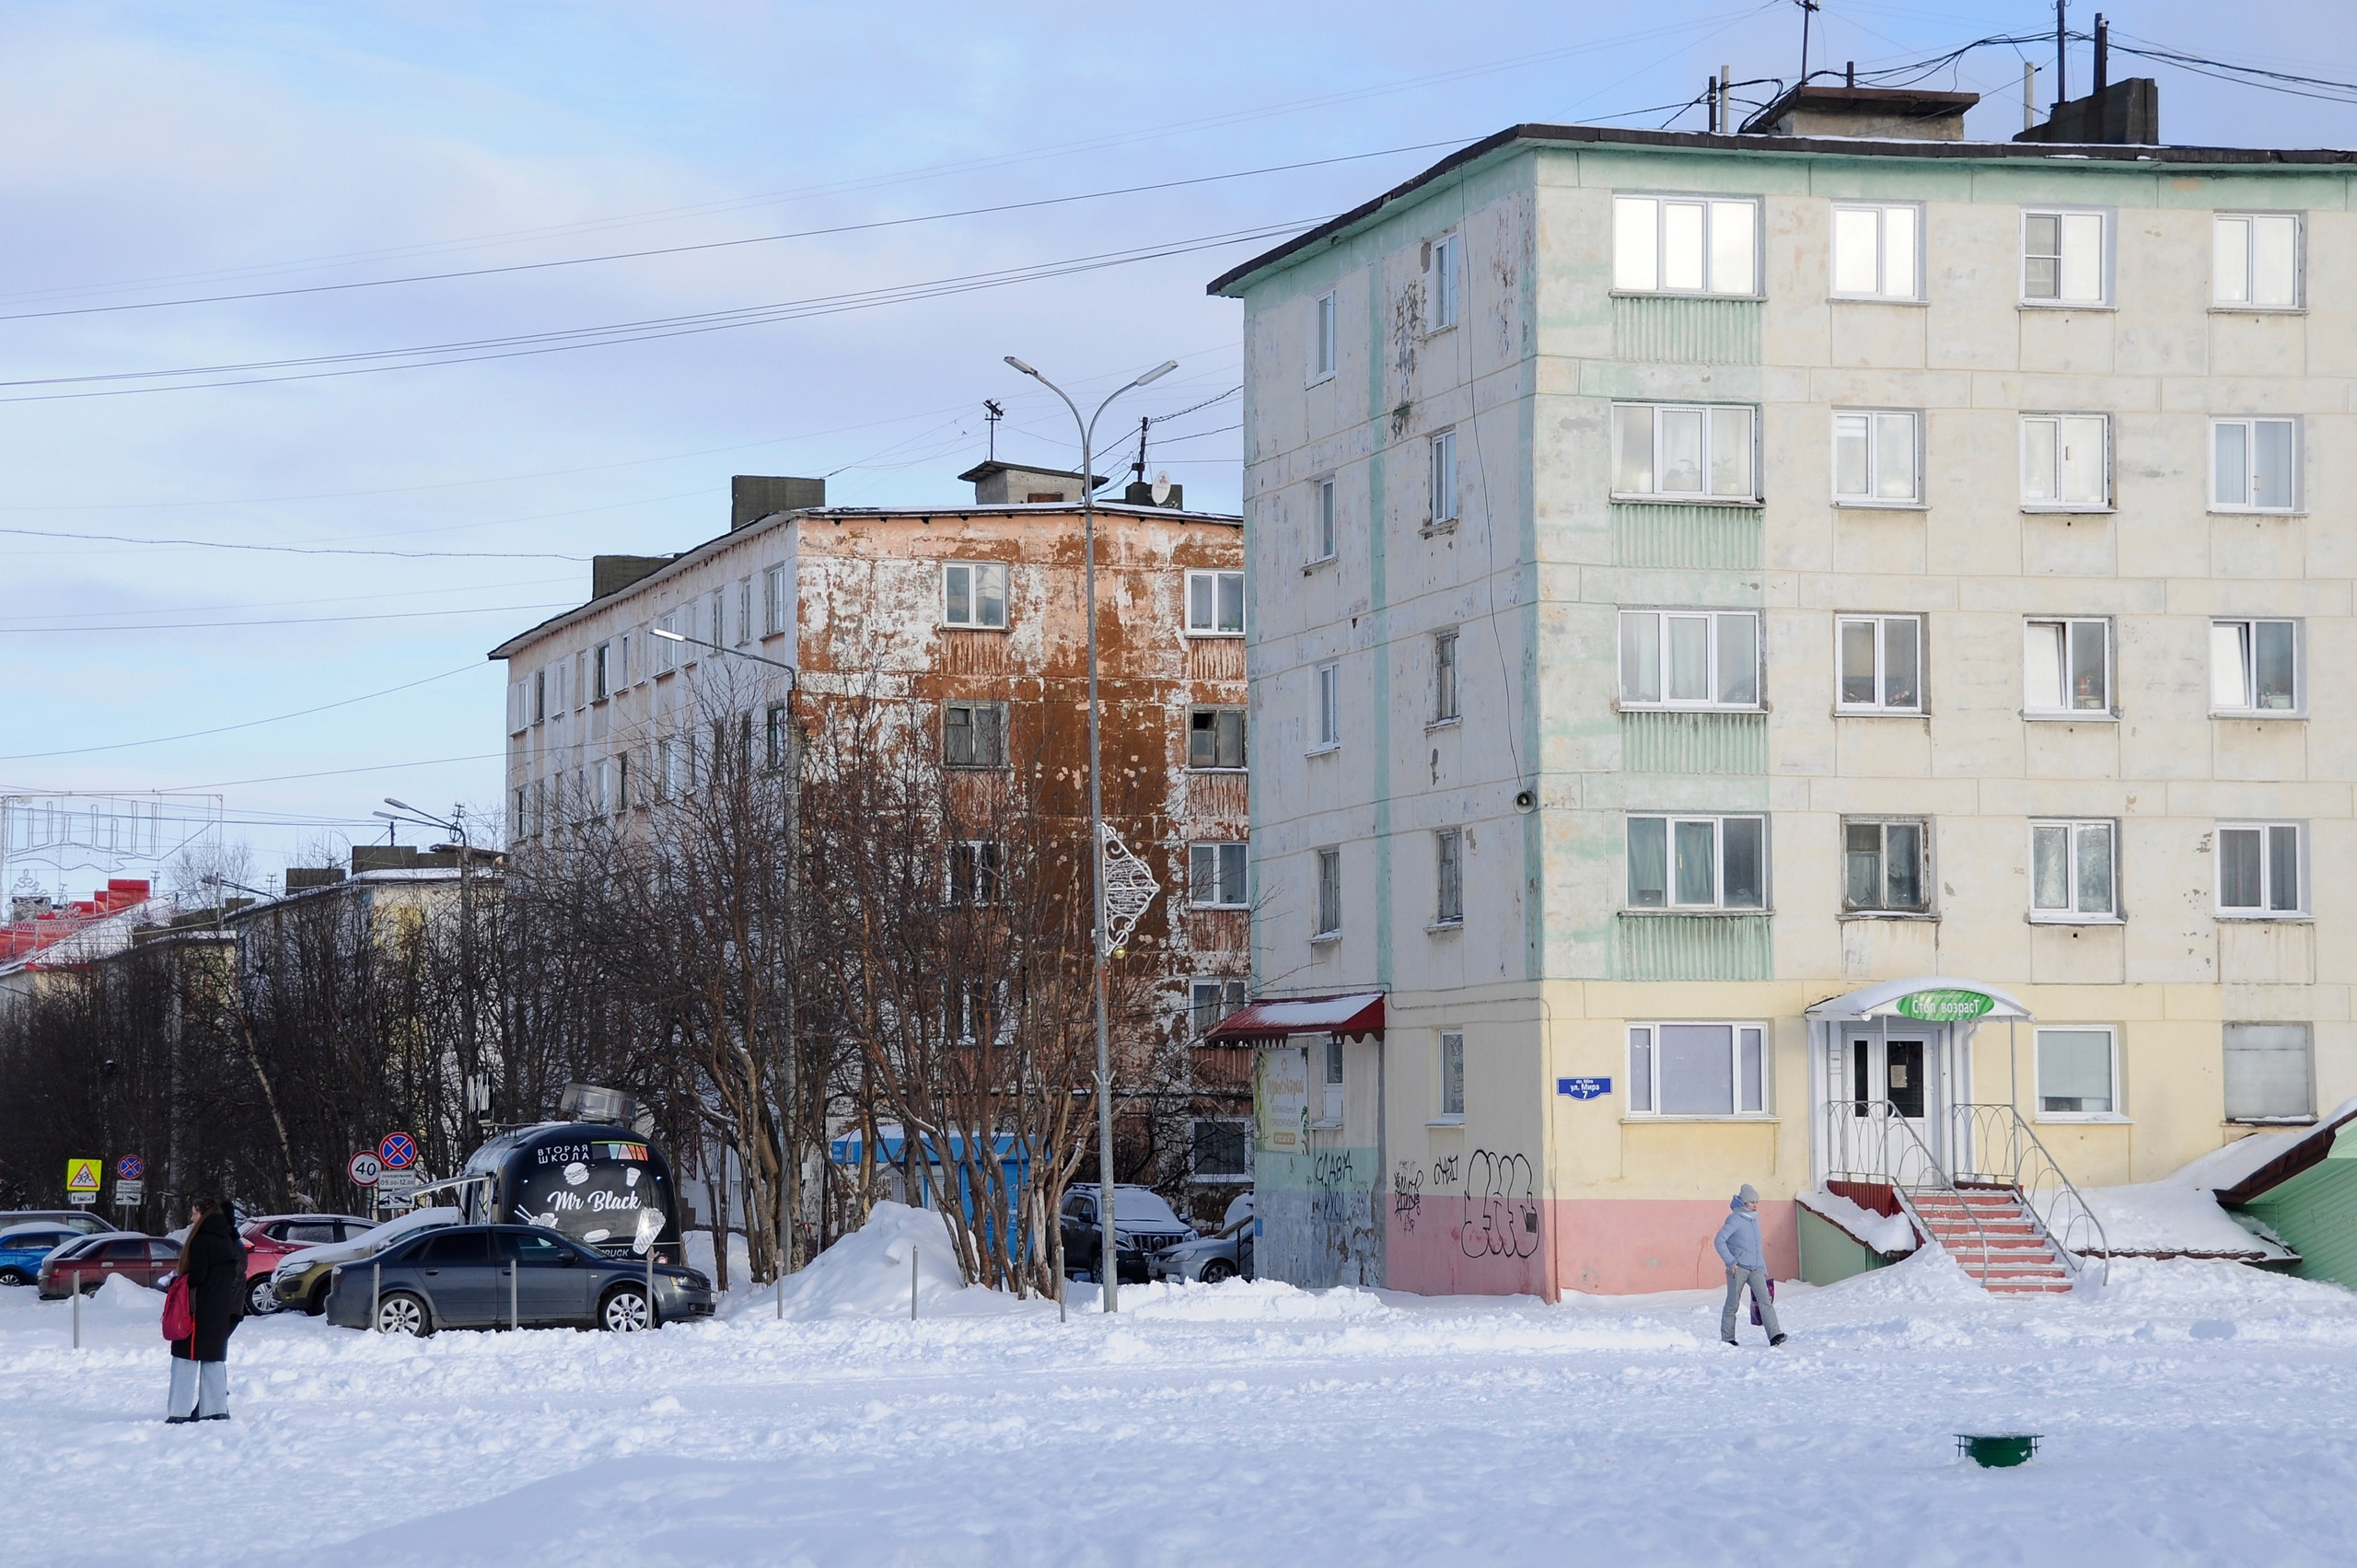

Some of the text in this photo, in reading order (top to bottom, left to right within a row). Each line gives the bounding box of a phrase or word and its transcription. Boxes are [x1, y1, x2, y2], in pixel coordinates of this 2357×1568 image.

[1912, 1000, 1936, 1014] Стоп
[1570, 1084, 1600, 1093] ул. Мира
[1582, 1091, 1588, 1099] 7
[537, 1144, 589, 1156] ВТОРАЯ
[538, 1152, 590, 1164] ШКОЛА
[354, 1161, 377, 1177] 40
[547, 1190, 643, 1213] Mr Black
